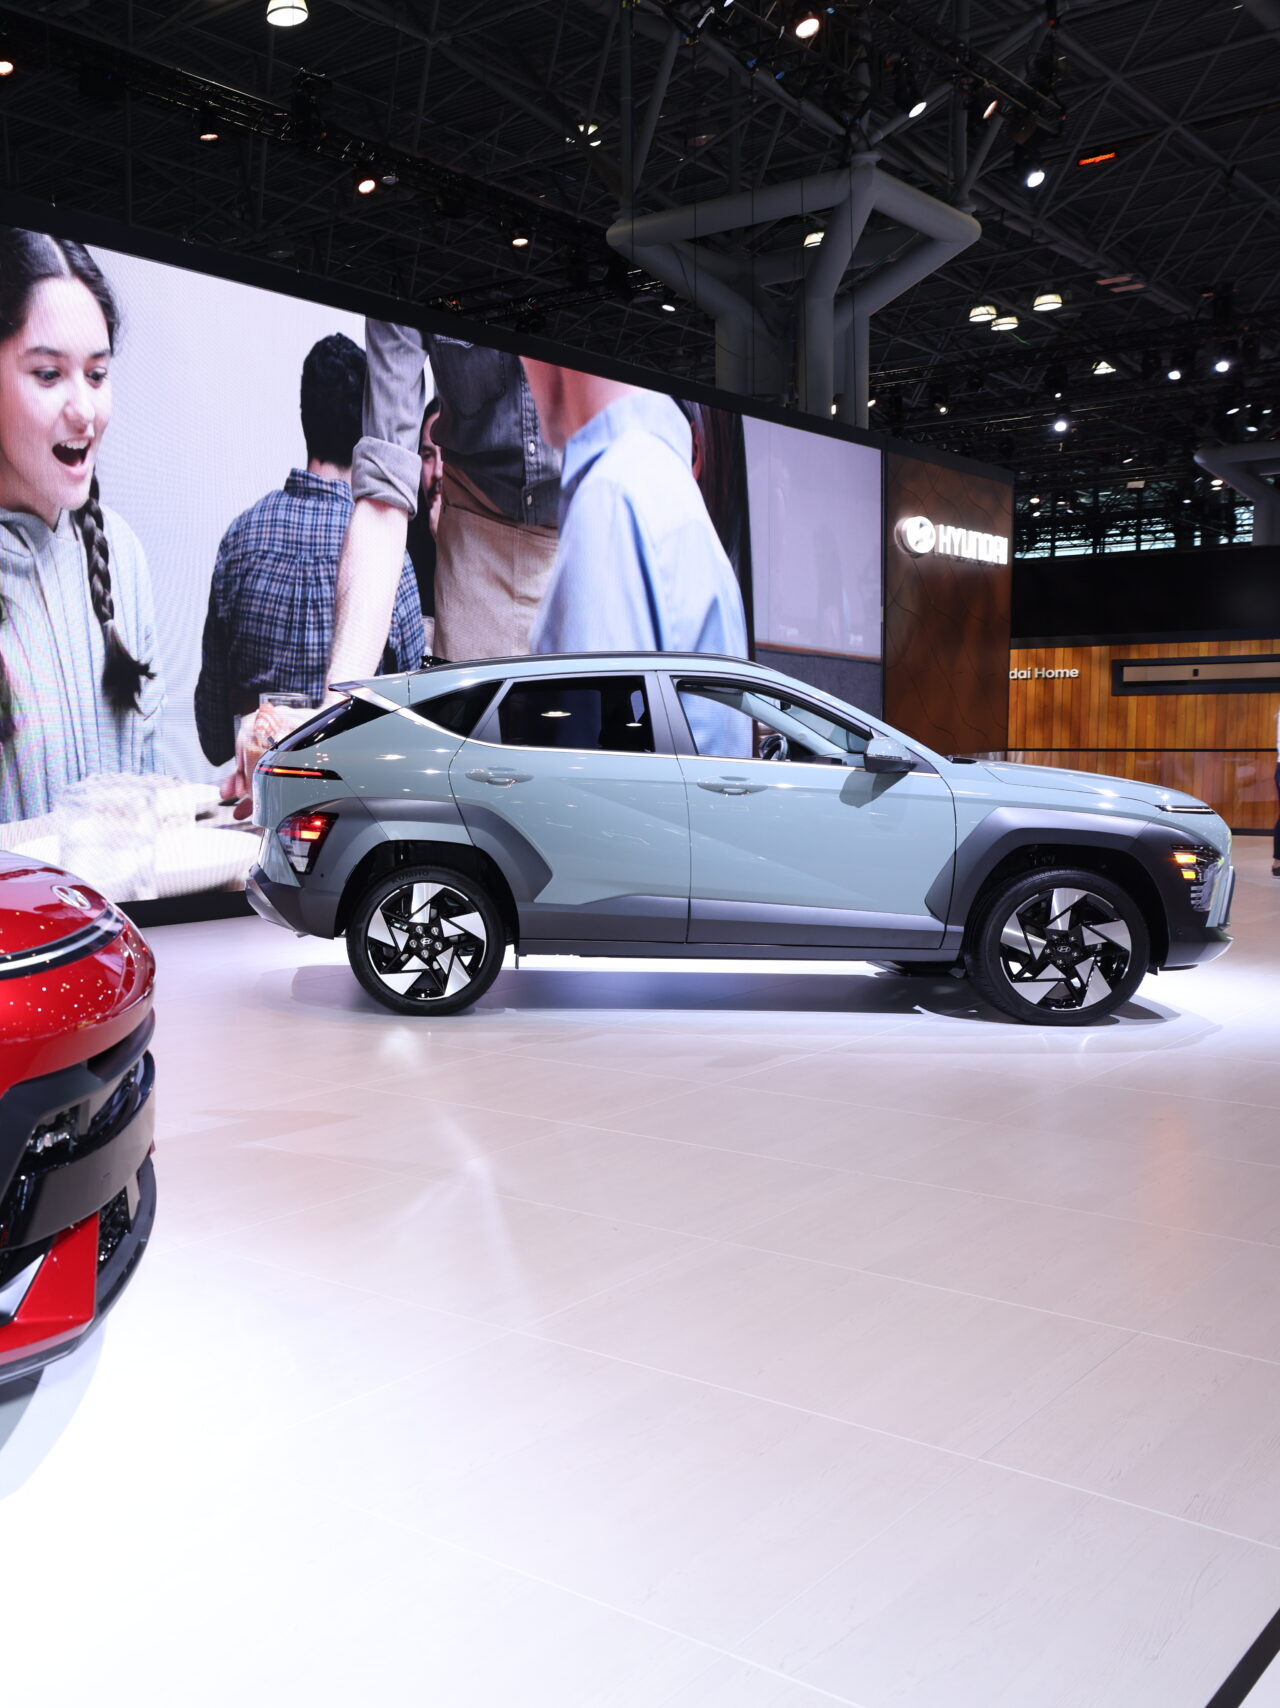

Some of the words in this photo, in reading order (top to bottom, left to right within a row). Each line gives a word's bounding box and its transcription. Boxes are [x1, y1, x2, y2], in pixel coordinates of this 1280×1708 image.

[938, 524, 1008, 565] HYUNDAI
[1009, 668, 1031, 679] dai
[1034, 667, 1079, 679] Home
